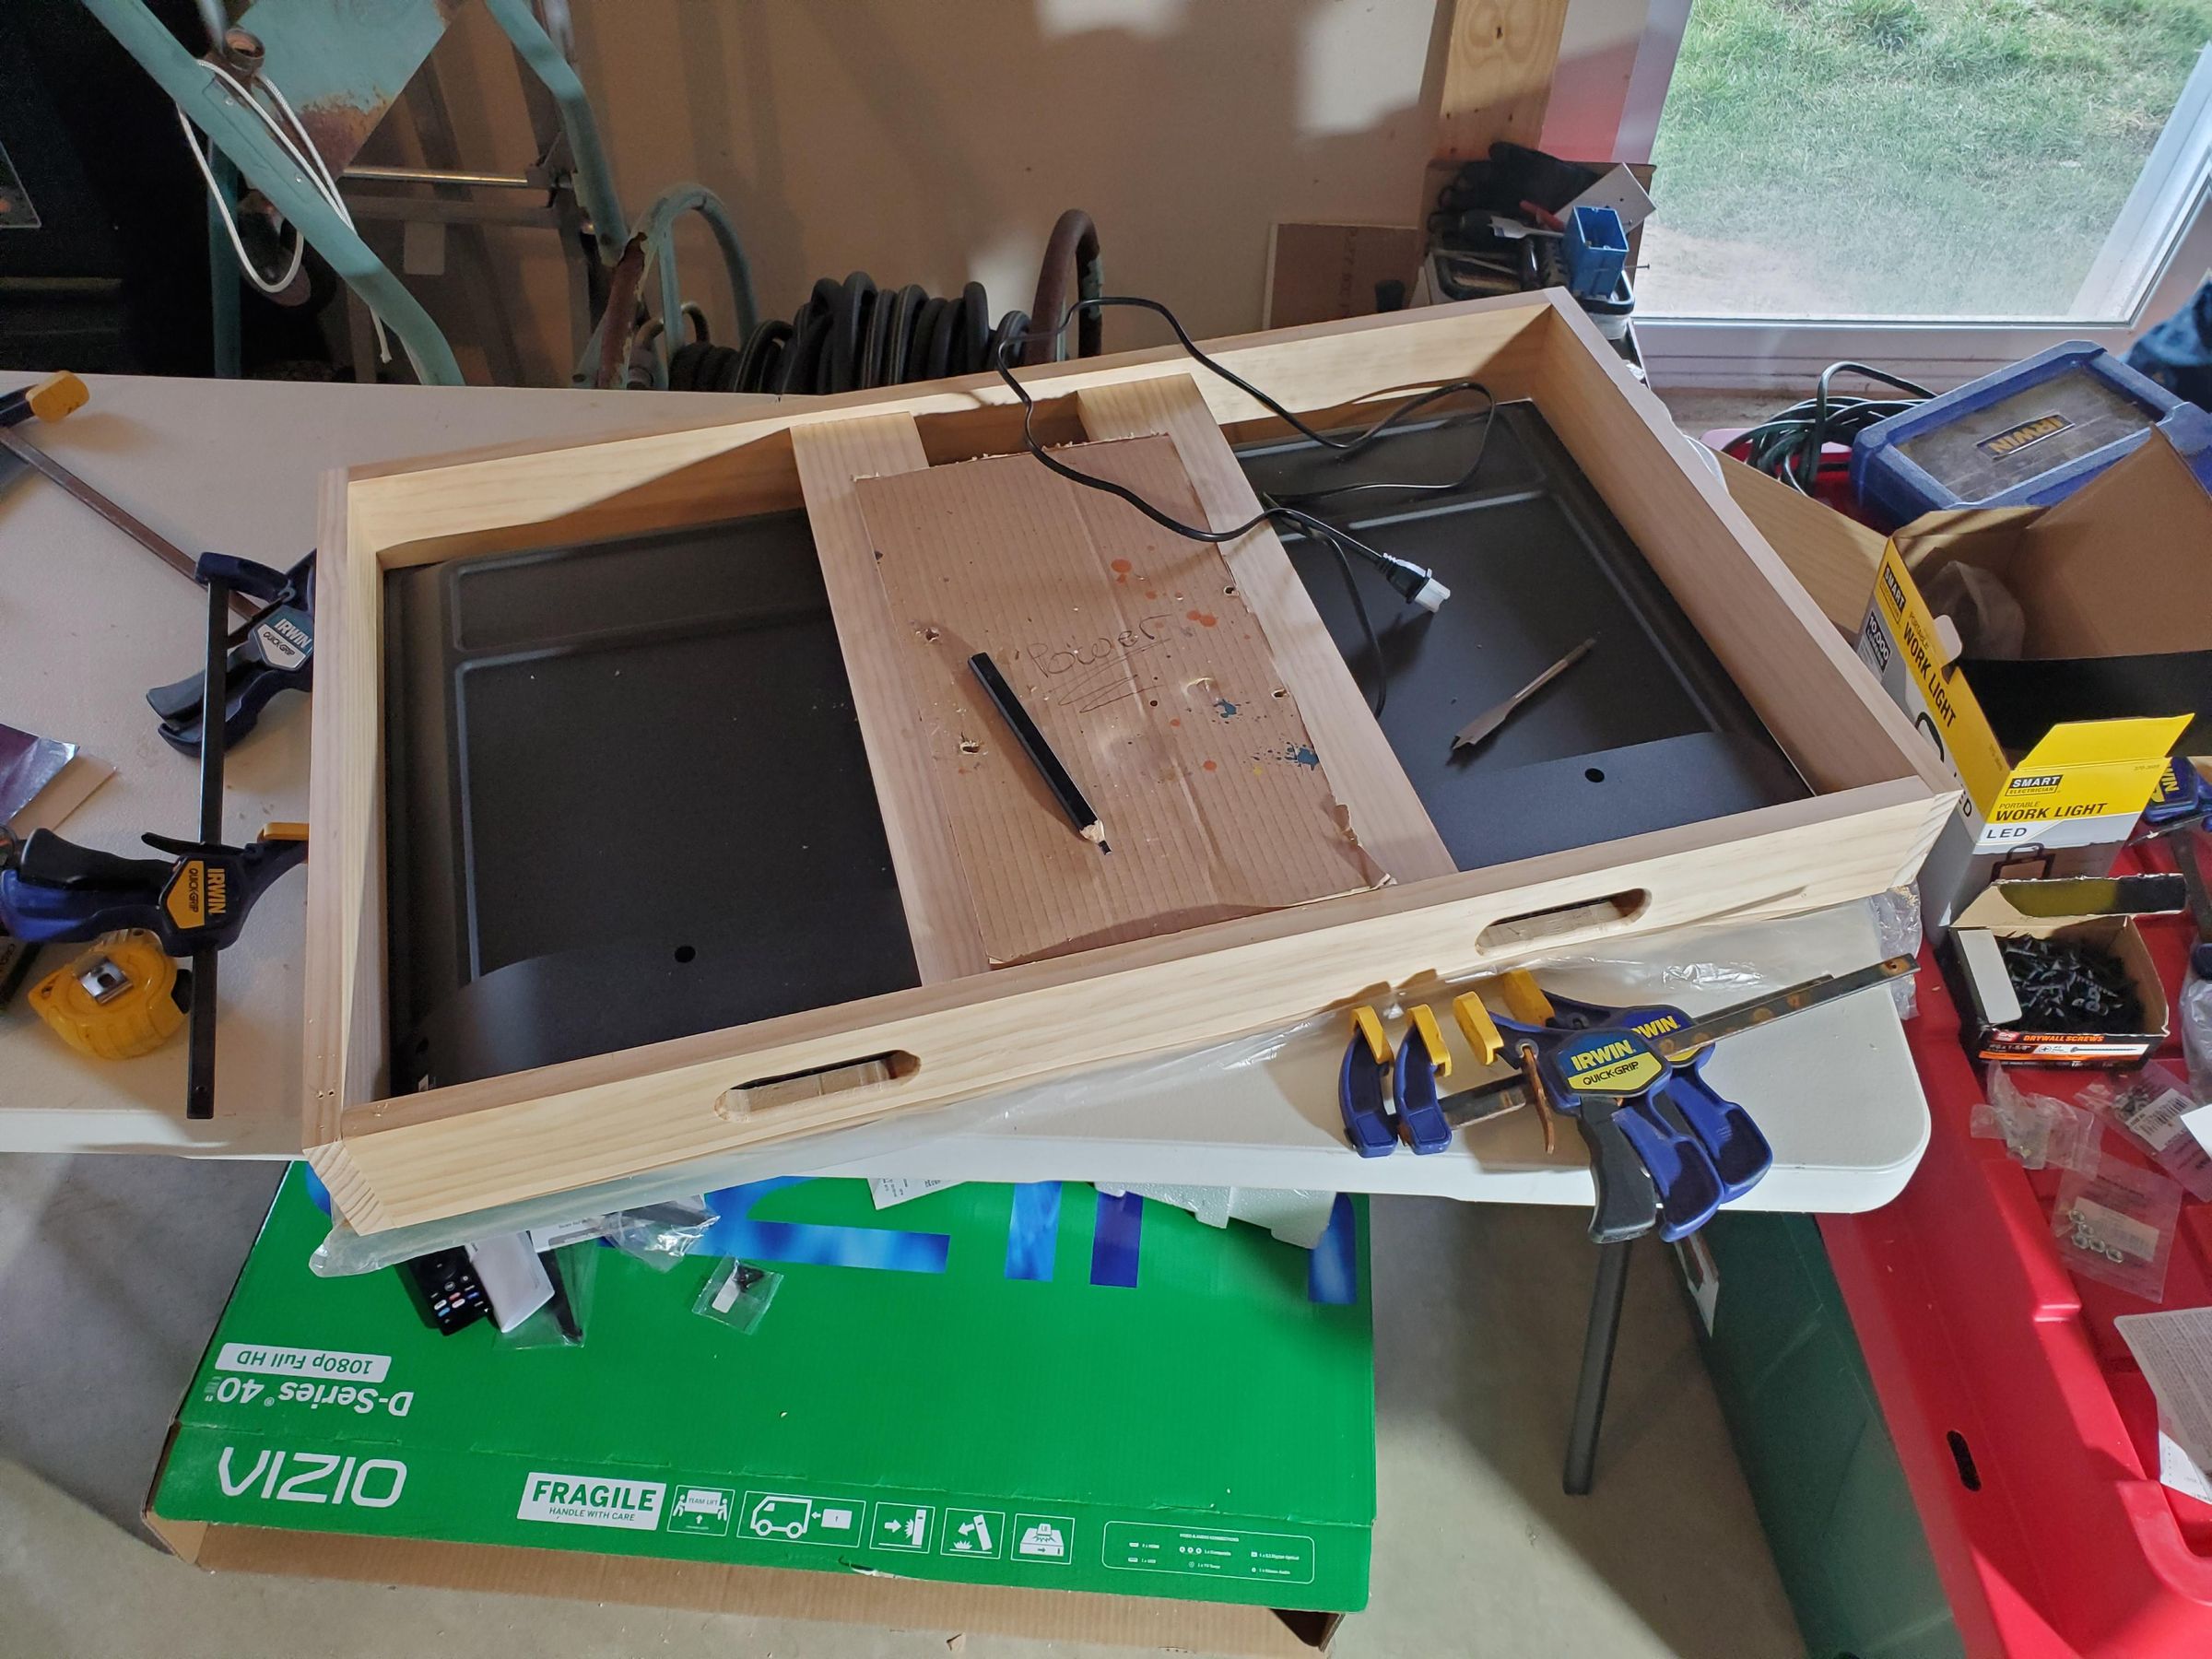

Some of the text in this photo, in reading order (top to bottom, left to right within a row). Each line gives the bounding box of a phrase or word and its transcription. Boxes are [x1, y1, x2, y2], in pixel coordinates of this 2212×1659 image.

[1987, 417, 2064, 454] IRWIN
[1884, 566, 1905, 609] SMART
[274, 618, 312, 649] IRWIN
[1868, 616, 1889, 662] 10,000
[1903, 623, 1957, 728] WORK LIGHT
[2012, 776, 2061, 788] SMART
[1995, 803, 2108, 822] WORK LIGHT
[1999, 801, 2041, 809] PORTABLE
[1986, 828, 2028, 839] LED
[207, 868, 227, 914] IRWIN
[1571, 1039, 1636, 1071] IRWIN
[236, 1350, 373, 1374] 1080p Full HD
[218, 1446, 407, 1508] VIZIO
[532, 1480, 657, 1512] FRAGILE
[548, 1506, 635, 1522] HANDLE WITH CARE
